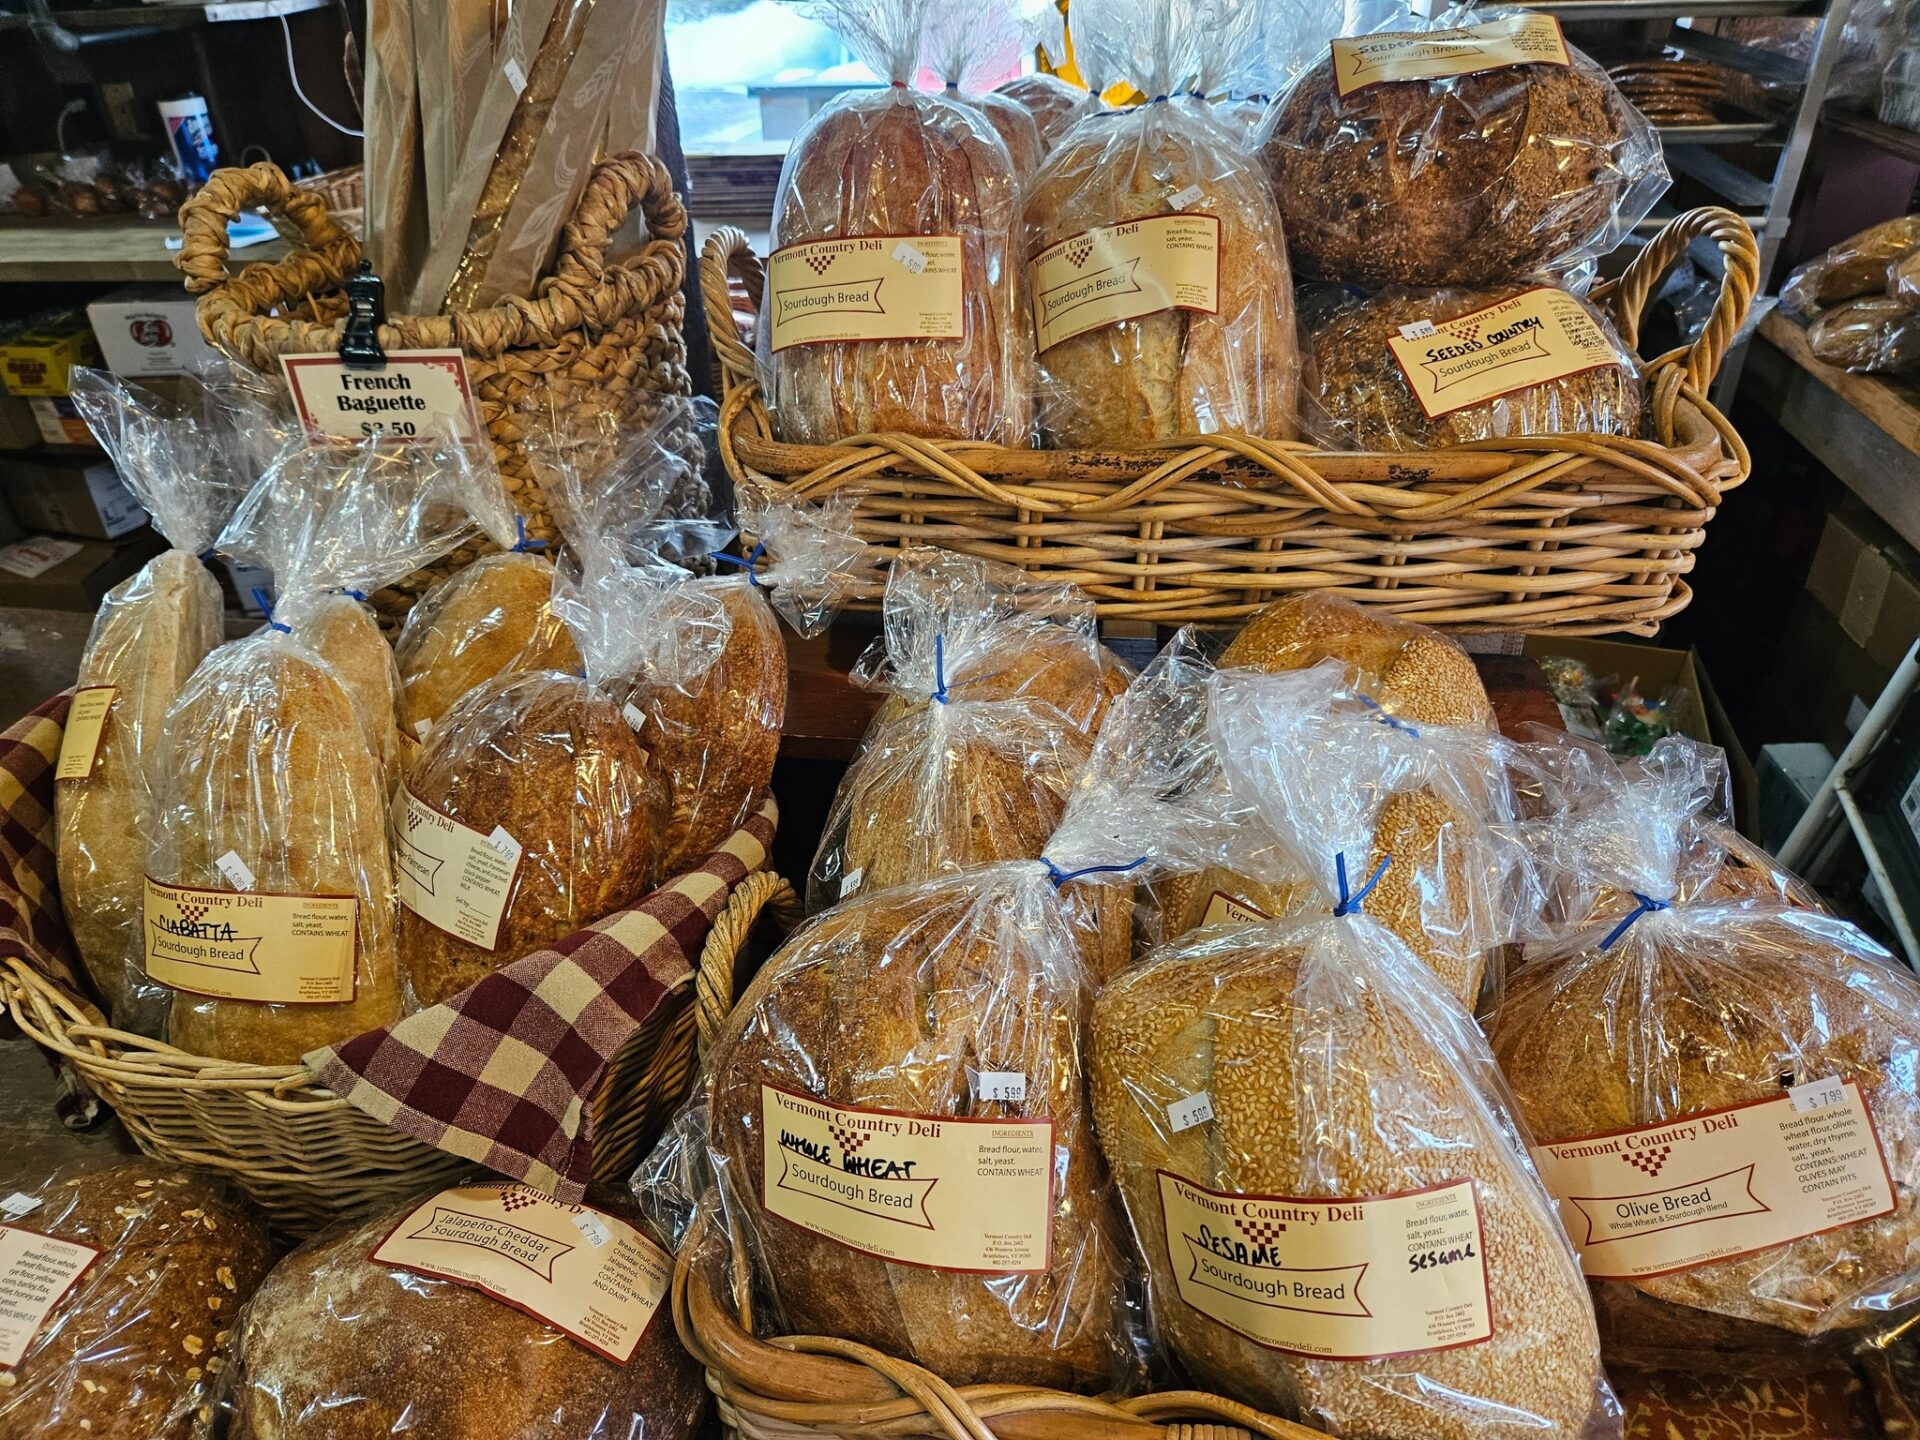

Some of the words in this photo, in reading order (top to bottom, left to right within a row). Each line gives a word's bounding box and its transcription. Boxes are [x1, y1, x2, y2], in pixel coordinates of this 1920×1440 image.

[1366, 48, 1430, 64] Sourugh
[773, 248, 808, 265] Vermont
[810, 242, 856, 256] Country
[859, 239, 883, 252] Deli
[1034, 246, 1066, 269] Vermont
[1069, 231, 1112, 250] Couy
[1116, 223, 1139, 237] Deli
[1196, 244, 1214, 252] WHEAT
[783, 293, 835, 312] Sourdough
[837, 290, 870, 303] Bread
[1047, 283, 1094, 311] Sourdough
[1096, 274, 1126, 291] Bread
[1450, 310, 1496, 332] Country
[1498, 298, 1523, 315] Deli
[1426, 340, 1484, 364] SEEDED
[1487, 316, 1546, 346] COUNTRY
[1439, 353, 1499, 378] Sourdough
[1500, 340, 1532, 357] Bread
[340, 373, 412, 391] French
[336, 395, 426, 415] Baguette
[411, 799, 436, 825] Country
[437, 816, 456, 833] Deli
[408, 854, 431, 878] Parmesan
[147, 880, 178, 902] Vermont
[181, 892, 233, 909] Country
[237, 896, 263, 909] Deli
[292, 912, 311, 920] Bread
[159, 914, 239, 944] CIABATTA
[291, 929, 324, 937] CONTAINS
[325, 930, 349, 938] WHEAT
[157, 935, 207, 959] Sourdough
[209, 947, 244, 961] Bread
[993, 1086, 999, 1099] $
[1004, 1086, 1022, 1100] 599
[1809, 1096, 1818, 1109] $
[1820, 1088, 1844, 1106] 799
[774, 1092, 831, 1122] Vermont
[835, 1112, 903, 1137] Country
[908, 1120, 941, 1138] Deli
[1183, 1114, 1190, 1126] $
[1192, 1105, 1210, 1123] 599
[1779, 1118, 1804, 1131] Bread
[1804, 1113, 1827, 1126] flour,
[1827, 1108, 1853, 1120] whole
[991, 1129, 1034, 1138] INGREDIENTS
[1548, 1140, 1622, 1161] Vermont
[1625, 1124, 1697, 1150] Country
[1701, 1113, 1740, 1135] Deli
[1784, 1129, 1810, 1142] wheat
[1810, 1125, 1833, 1136] flour,
[1832, 1118, 1858, 1131] olives,
[1788, 1141, 1813, 1153] water,
[1813, 1137, 1828, 1150] dry
[1828, 1130, 1857, 1144] thyme,
[978, 1156, 993, 1165] salt,
[979, 1144, 1001, 1153] Bread
[1002, 1144, 1021, 1154] flour,
[1791, 1152, 1808, 1163] salt,
[1838, 1148, 1868, 1162] WHEAT
[842, 1151, 917, 1179] WHEAT
[977, 1167, 1016, 1177] CONTAINS
[1017, 1167, 1044, 1177] WHEAT
[1798, 1170, 1828, 1183] OLIVES
[1828, 1165, 1847, 1177] MAY
[791, 1163, 864, 1201] Sourdough
[868, 1187, 914, 1209] Bread
[1802, 1179, 1840, 1194] CONTAIN
[1840, 1173, 1858, 1186] PITS
[513, 1183, 566, 1210] Country
[1174, 1182, 1237, 1216] Vermont
[1242, 1202, 1322, 1226] Country
[1327, 1206, 1364, 1222] Deli
[1416, 1193, 1457, 1209] INGREDIENTS
[1615, 1199, 1660, 1220] Olive
[1662, 1187, 1713, 1211] Bread
[1405, 1216, 1428, 1229] Bread
[1429, 1213, 1448, 1225] flour,
[1448, 1208, 1470, 1220] water,
[1608, 1219, 1632, 1231] Whole
[1631, 1215, 1658, 1228] Wheat
[1658, 1213, 1666, 1222] &
[1666, 1206, 1706, 1222] Sourdough
[1706, 1201, 1728, 1214] Blend
[430, 1224, 498, 1248] Sourdough
[500, 1241, 539, 1264] Bread
[439, 1213, 551, 1254] Jalapeño-Cheddar
[579, 1223, 589, 1232] $
[585, 1229, 603, 1248] 799
[1196, 1224, 1282, 1267] SESAME
[1407, 1230, 1422, 1241] salt,
[1407, 1237, 1447, 1252] CONTAINS
[1447, 1231, 1473, 1245] WHEAT
[16, 1260, 36, 1269] wheat
[23, 1250, 43, 1260] Bread
[57, 1260, 78, 1270] whole
[603, 1263, 616, 1275] salt,
[612, 1247, 641, 1269] Cheddar
[617, 1238, 637, 1256] Bread
[635, 1249, 652, 1266] flour,
[651, 1260, 670, 1279] water,
[1631, 1243, 1743, 1275] www.vermontcountrydeli.com
[592, 1279, 609, 1292] AND
[608, 1287, 629, 1303] DAIRY
[597, 1271, 631, 1294] CONTAINS
[631, 1289, 655, 1309] WHEAT
[1202, 1259, 1288, 1298] Sourdough
[1293, 1282, 1345, 1300] Bread
[13, 1311, 37, 1323] WHEAT
[1222, 1318, 1333, 1354] www.vermontcountrydeli.com
